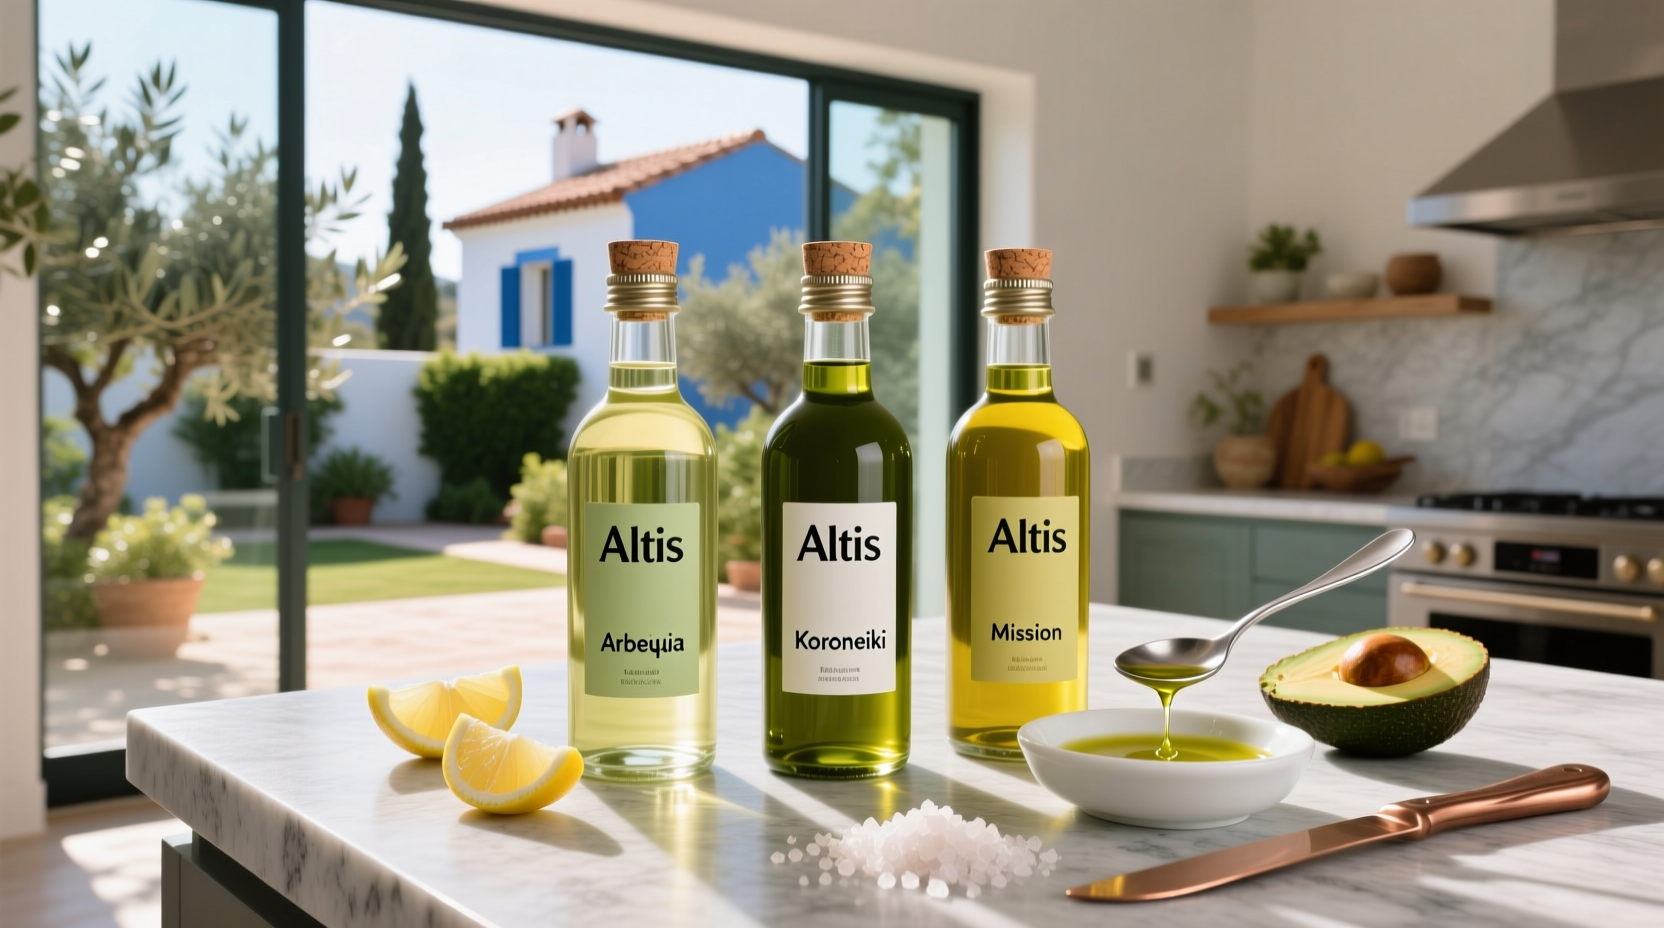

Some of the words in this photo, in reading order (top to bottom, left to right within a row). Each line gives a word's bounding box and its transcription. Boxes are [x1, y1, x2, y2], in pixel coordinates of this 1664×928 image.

[598, 525, 684, 564] Altis
[797, 525, 881, 562] Altis
[988, 518, 1067, 554] Altis
[796, 629, 886, 651] Koroneiki
[992, 623, 1062, 642] Mission
